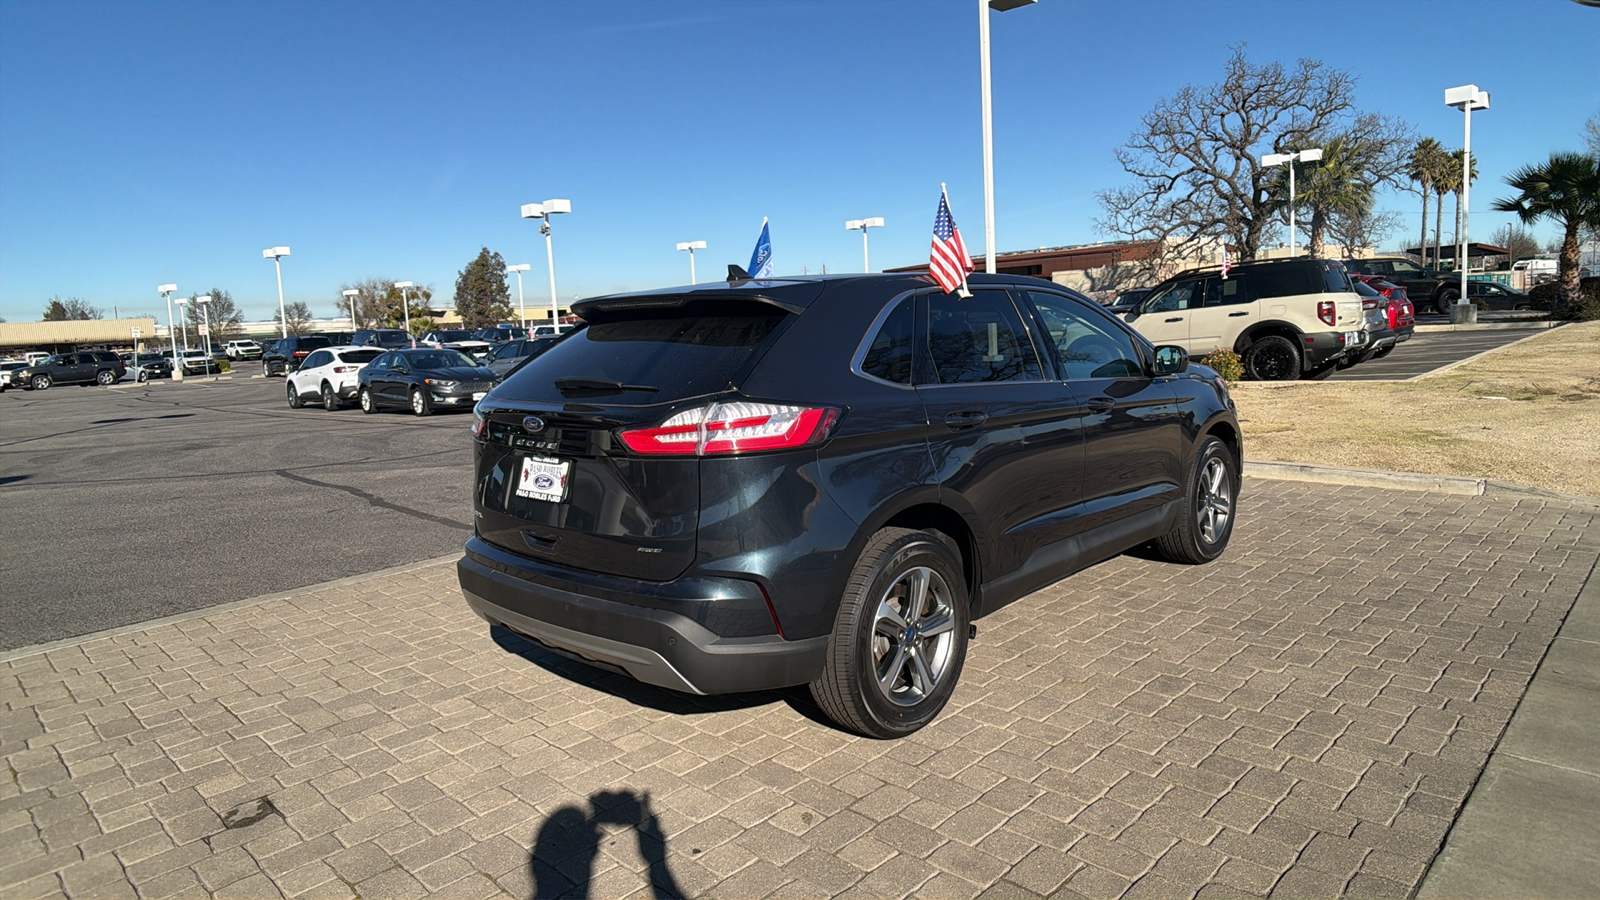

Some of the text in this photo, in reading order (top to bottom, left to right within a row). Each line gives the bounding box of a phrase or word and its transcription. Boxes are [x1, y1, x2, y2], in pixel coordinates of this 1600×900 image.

[530, 464, 563, 479] PASO ROBLES
[516, 489, 529, 497] PASO
[529, 491, 547, 501] ROBLES
